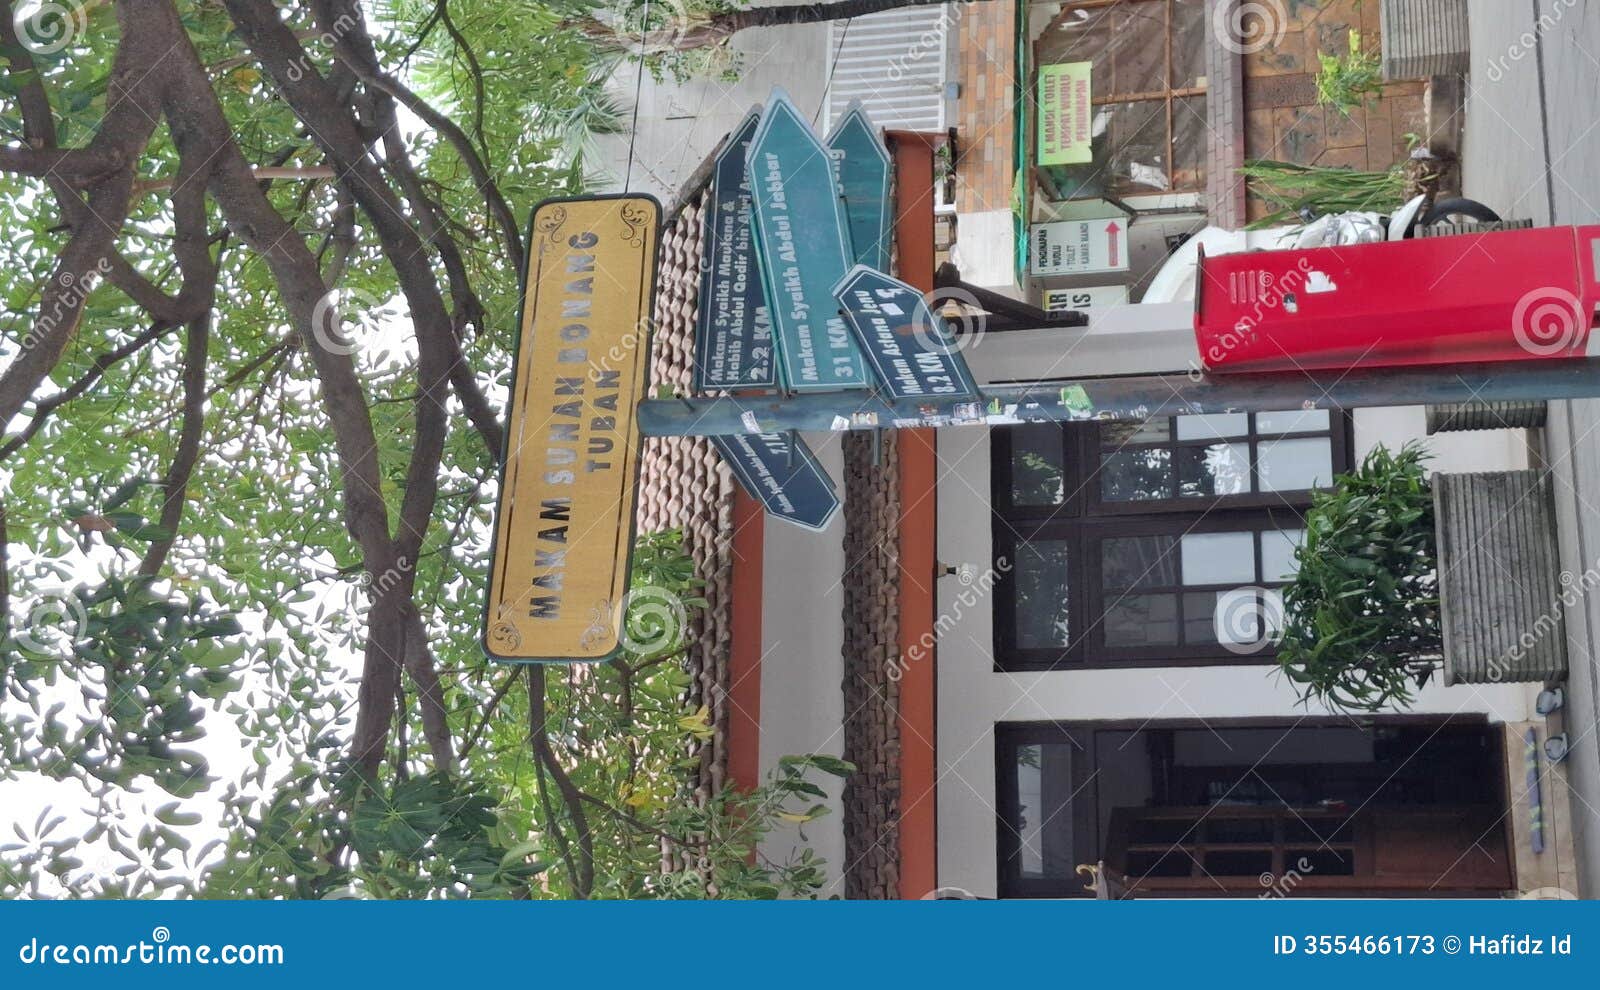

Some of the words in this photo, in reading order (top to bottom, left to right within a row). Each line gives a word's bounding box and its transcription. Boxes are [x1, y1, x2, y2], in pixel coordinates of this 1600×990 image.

[764, 152, 789, 211] Jabbar
[721, 201, 735, 212] &
[718, 216, 734, 277] Maulana
[736, 228, 749, 250] bin
[773, 216, 796, 263] Abdul
[733, 254, 747, 293] Qodir
[786, 267, 810, 320] Syaikh
[556, 232, 598, 363] BONANG
[715, 280, 734, 327] Syaikh
[731, 297, 745, 337] Abdul
[753, 306, 771, 341] KM
[826, 318, 848, 349] KM
[871, 317, 903, 356] Astana
[711, 331, 727, 382] Makam
[728, 340, 743, 381] Habib
[751, 347, 769, 381] 2.2
[796, 325, 819, 381] Makam
[835, 356, 853, 377] 31
[914, 351, 946, 373] KM
[892, 358, 924, 394] Makam
[926, 375, 957, 393] 8.2
[542, 377, 585, 485] SUNAN
[585, 369, 620, 473] TUBAN
[528, 497, 572, 619] MAKAM
